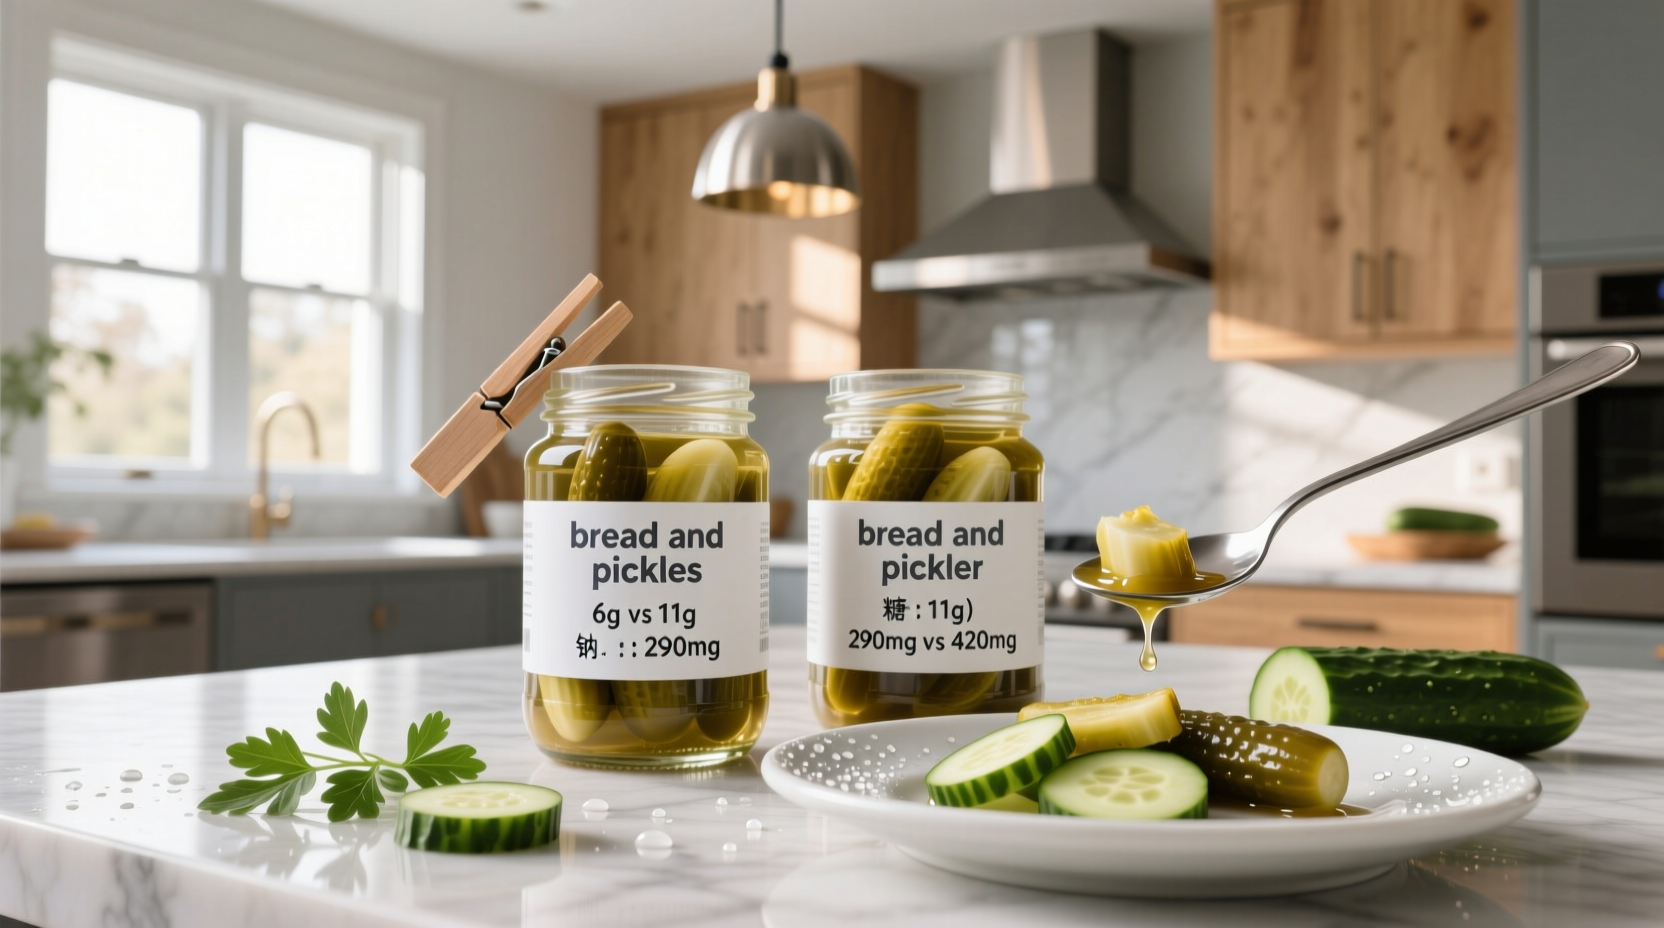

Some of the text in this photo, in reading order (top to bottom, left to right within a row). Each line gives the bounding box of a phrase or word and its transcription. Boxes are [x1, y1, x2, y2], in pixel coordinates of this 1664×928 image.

[570, 520, 724, 550] bread and
[858, 518, 1004, 547] bread and
[592, 554, 703, 591] pickles
[881, 552, 984, 587] pickler
[592, 601, 696, 630] 6g vs 11g
[644, 635, 720, 662] 290mg
[847, 628, 1017, 657] 290mg vs 420mg
